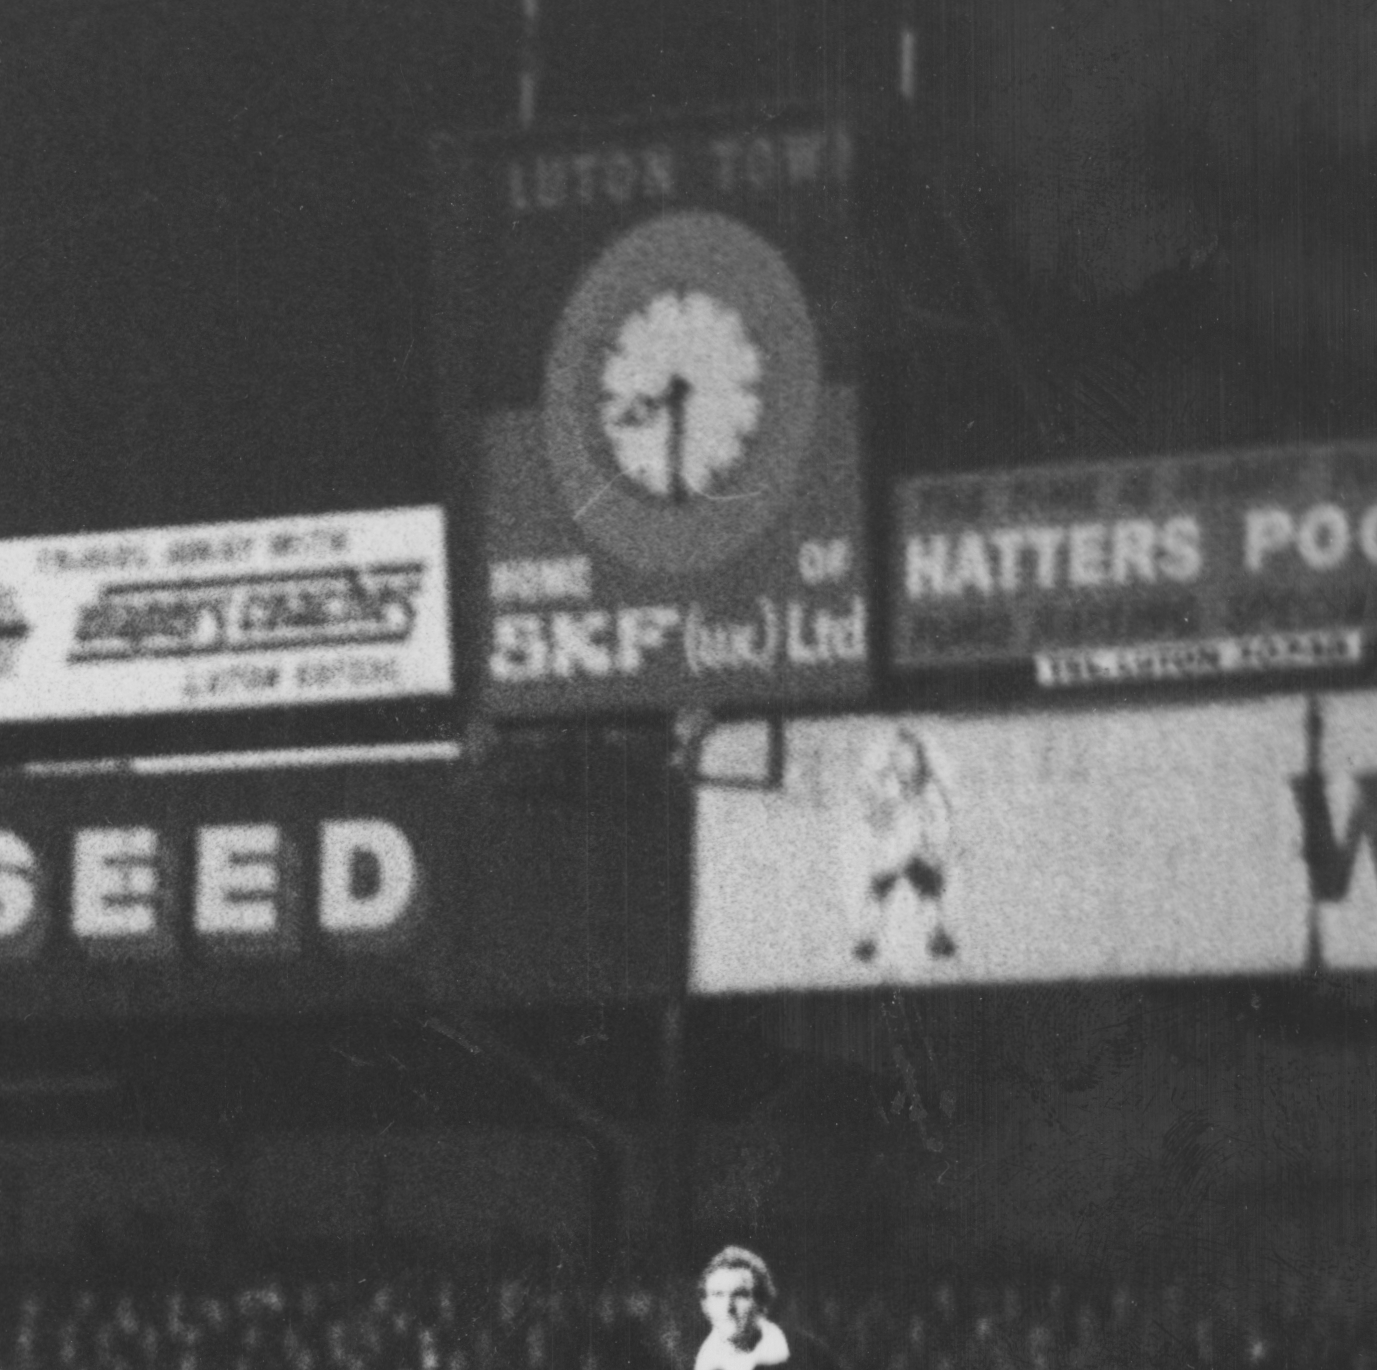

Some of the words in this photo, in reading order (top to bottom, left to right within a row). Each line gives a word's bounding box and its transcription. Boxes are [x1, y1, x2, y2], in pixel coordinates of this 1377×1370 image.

[507, 145, 675, 211] LUTON
[797, 536, 850, 586] OF
[904, 513, 1204, 600] HATTERS
[488, 605, 682, 683] SKF
